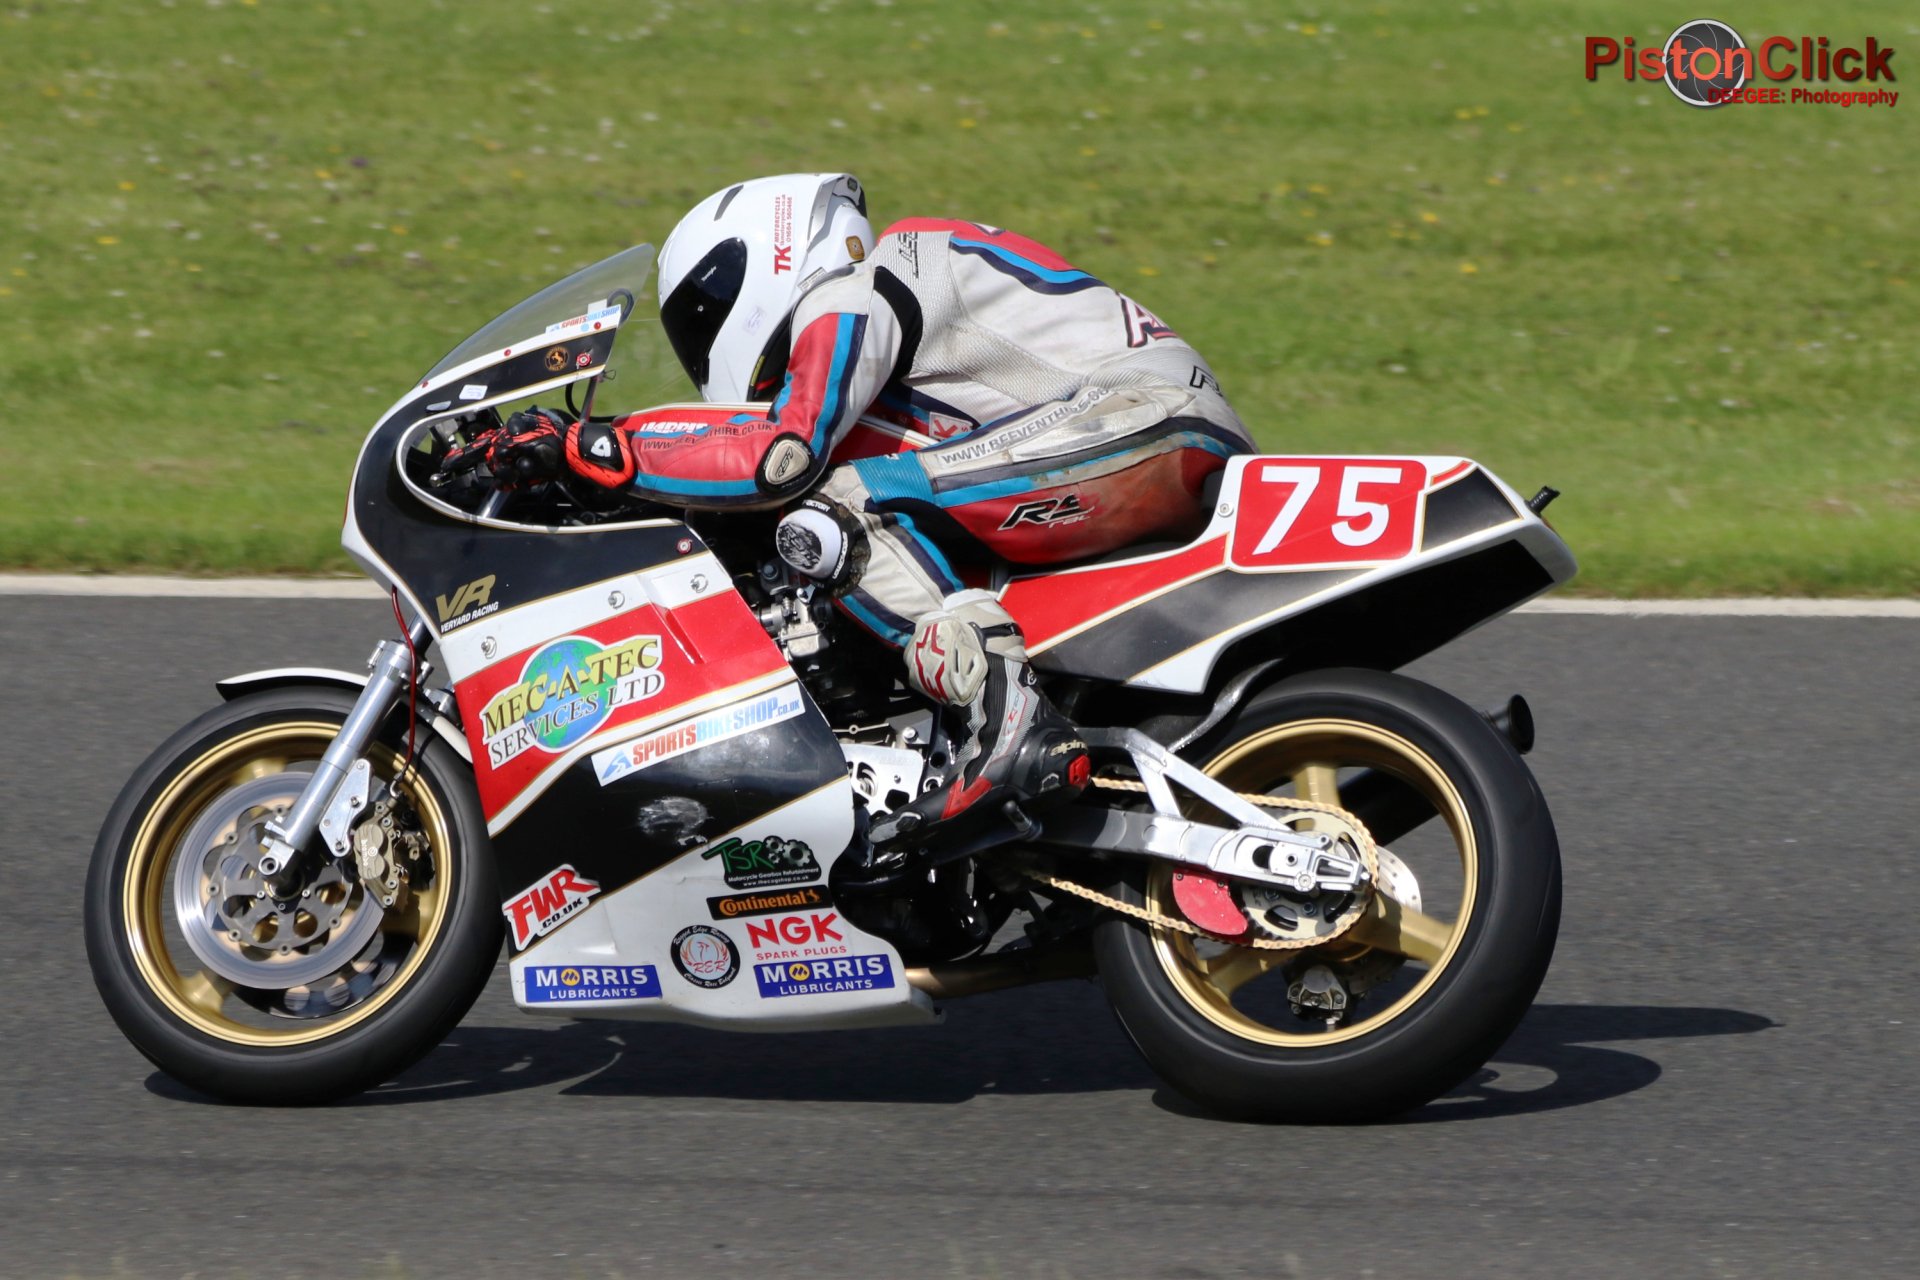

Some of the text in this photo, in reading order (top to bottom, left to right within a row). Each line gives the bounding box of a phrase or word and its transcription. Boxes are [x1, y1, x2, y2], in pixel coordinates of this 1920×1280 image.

[774, 243, 792, 276] TK
[1252, 465, 1402, 555] 75
[435, 574, 496, 622] VR
[440, 601, 499, 633] VERYARD RACING
[482, 639, 659, 740] MEC-A-TEC
[491, 673, 662, 765] SERVICES LTD
[704, 838, 775, 873] TSR
[728, 867, 820, 883] Motorcycle Gearbox Refurbishment
[503, 868, 600, 945] FWR
[719, 891, 808, 916] Continental
[745, 912, 843, 949] NGK
[692, 960, 726, 974] RER
[756, 945, 847, 961] SPARK PLUGS
[535, 968, 648, 987] MORRIS
[761, 956, 884, 984] MORRIS
[550, 988, 638, 999] LUBRICANTS
[780, 979, 873, 995] LUBRICANTS
